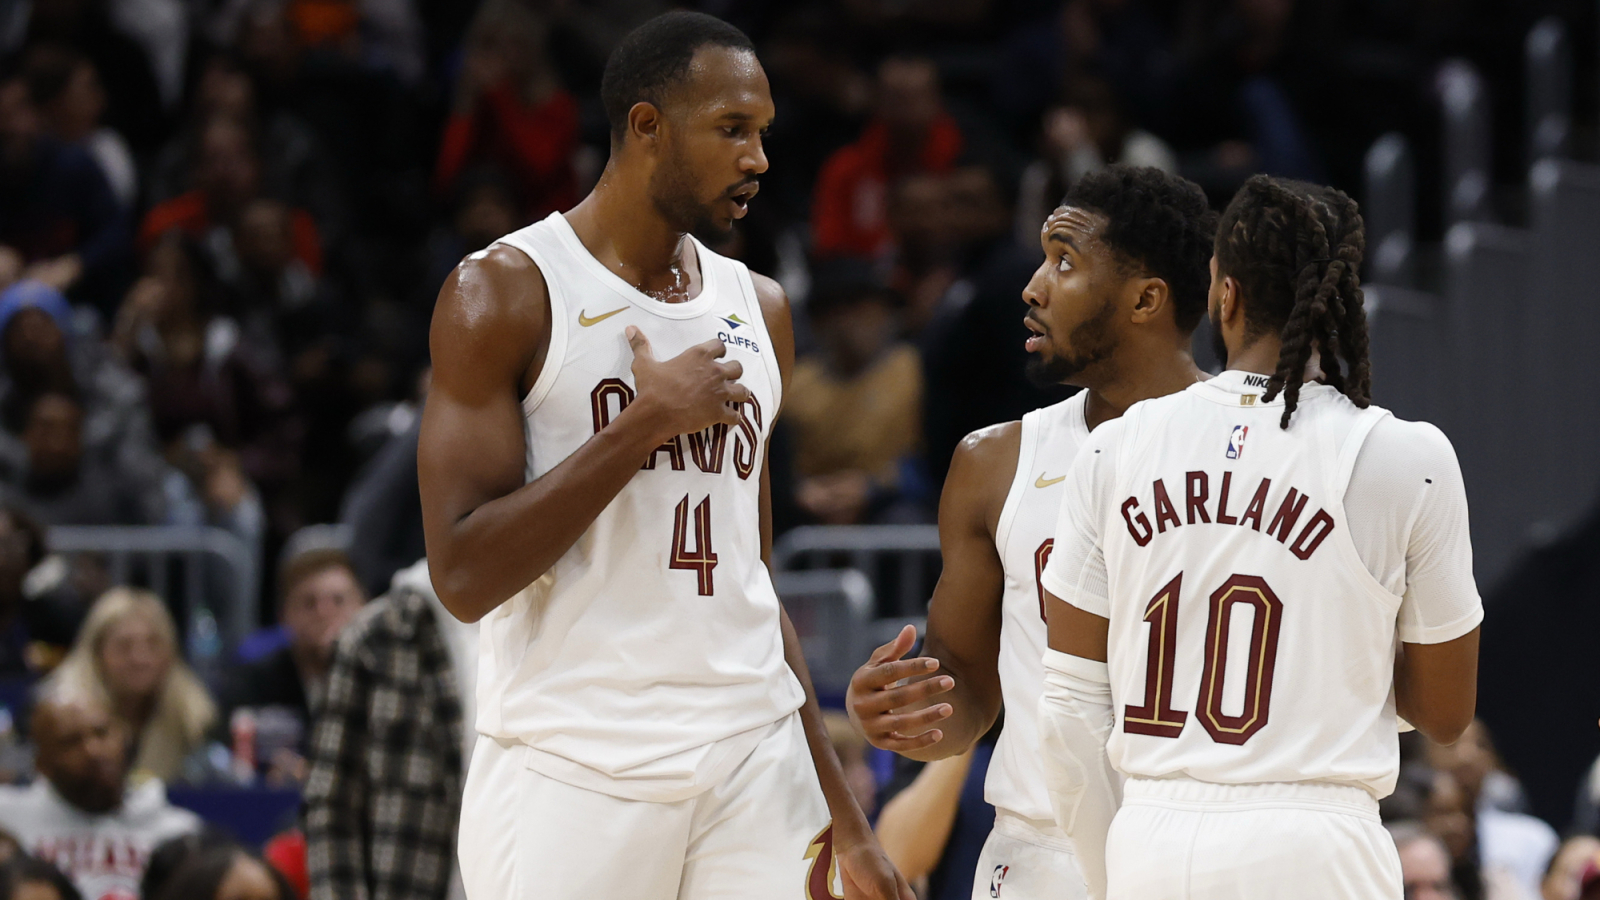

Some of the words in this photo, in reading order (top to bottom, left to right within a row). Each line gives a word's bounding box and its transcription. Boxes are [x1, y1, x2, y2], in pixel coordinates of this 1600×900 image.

[717, 331, 760, 353] CLIFFS
[668, 492, 718, 597] 4
[1121, 470, 1335, 561] GARLAND
[1124, 570, 1283, 746] 10
